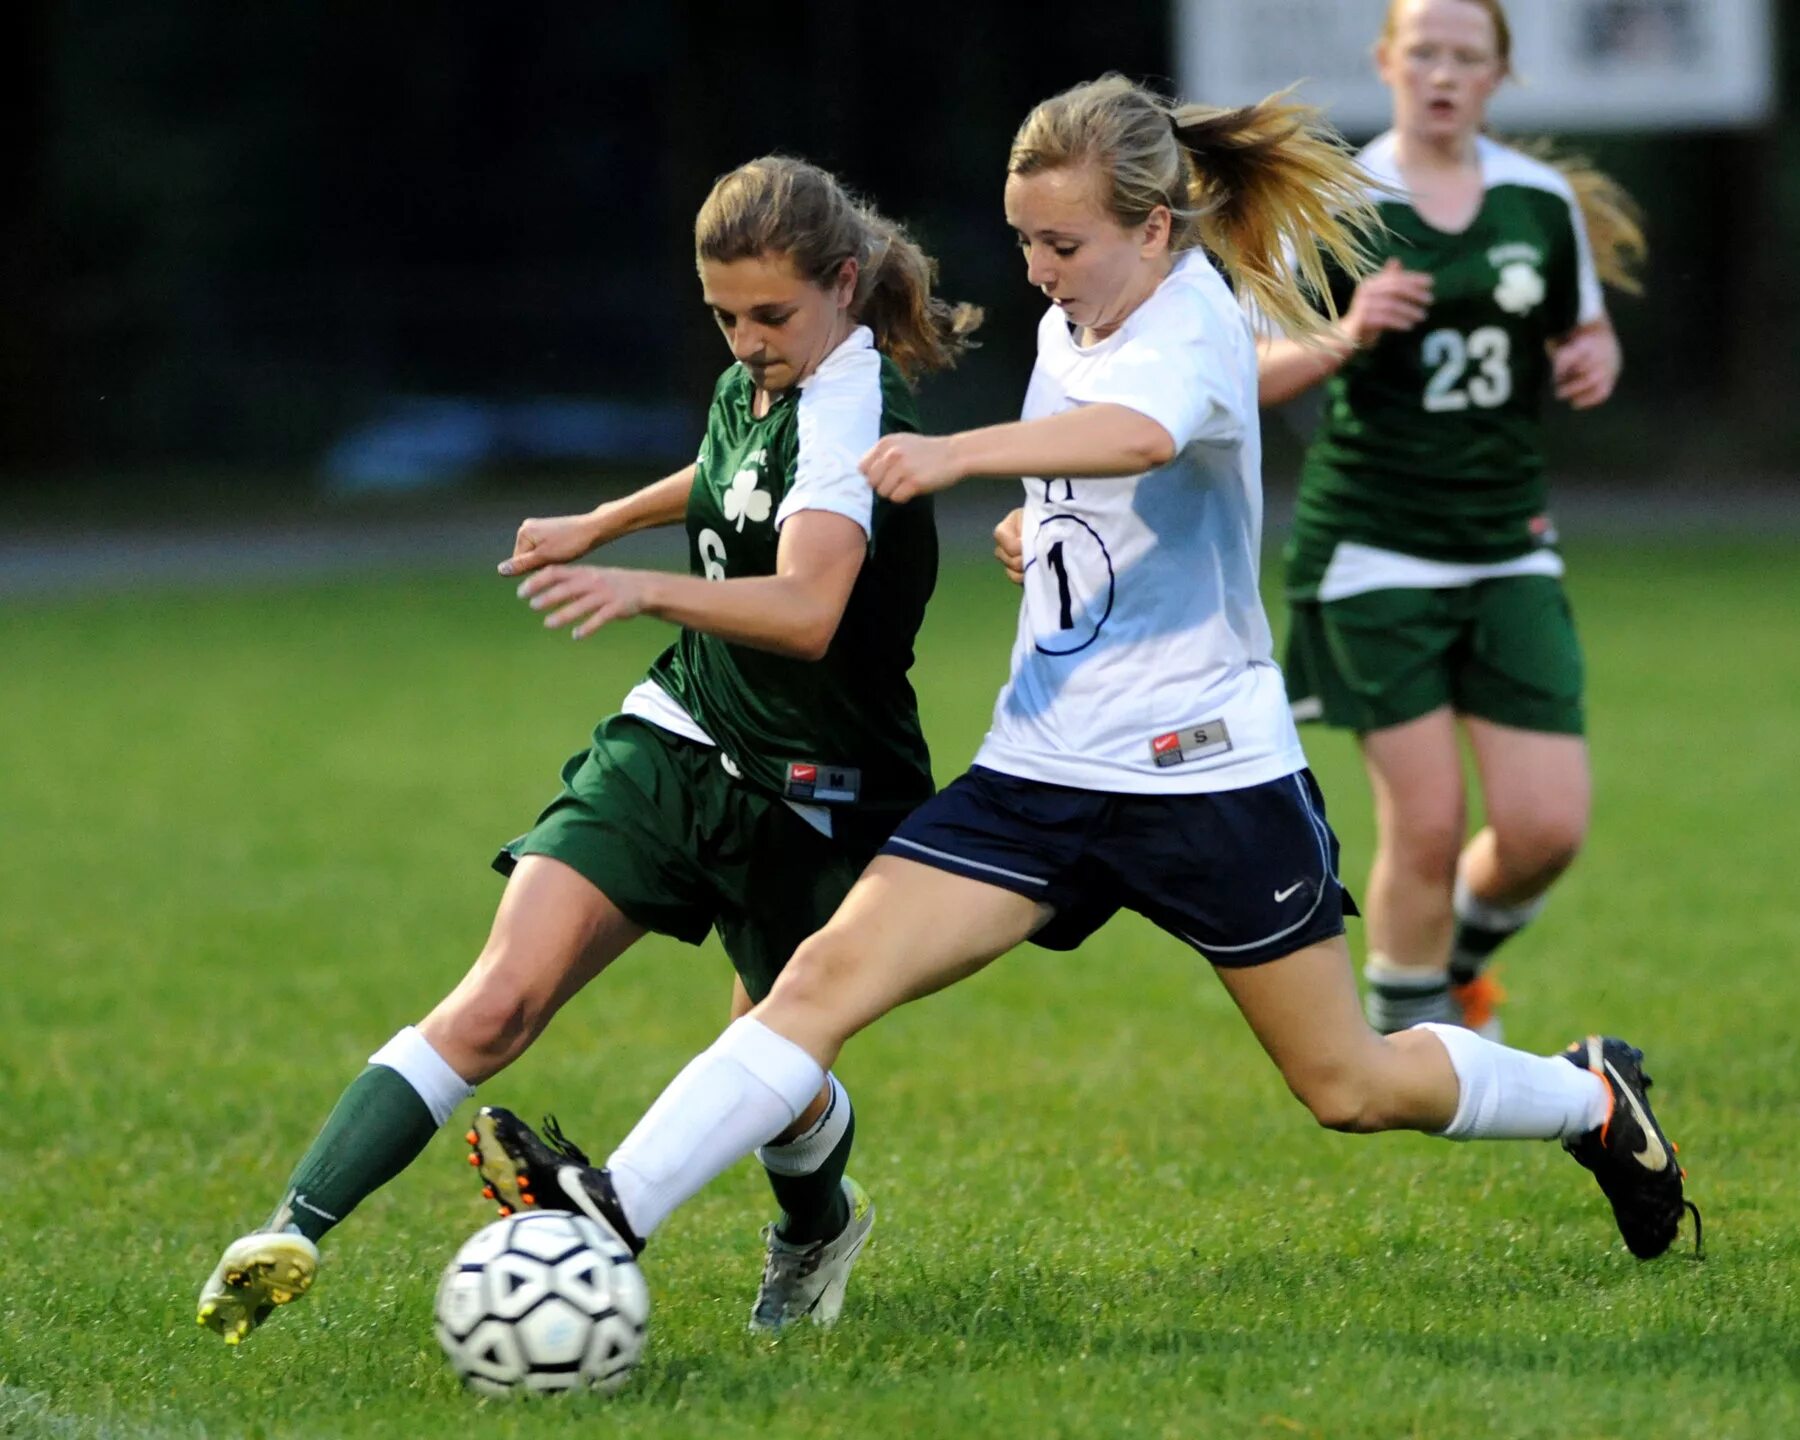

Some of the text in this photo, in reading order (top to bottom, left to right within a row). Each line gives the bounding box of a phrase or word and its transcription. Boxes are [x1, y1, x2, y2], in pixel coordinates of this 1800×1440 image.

[1421, 326, 1511, 412] 23
[698, 528, 727, 581] 6
[1047, 541, 1074, 630] 1
[1194, 730, 1208, 743] S
[830, 773, 844, 787] M
